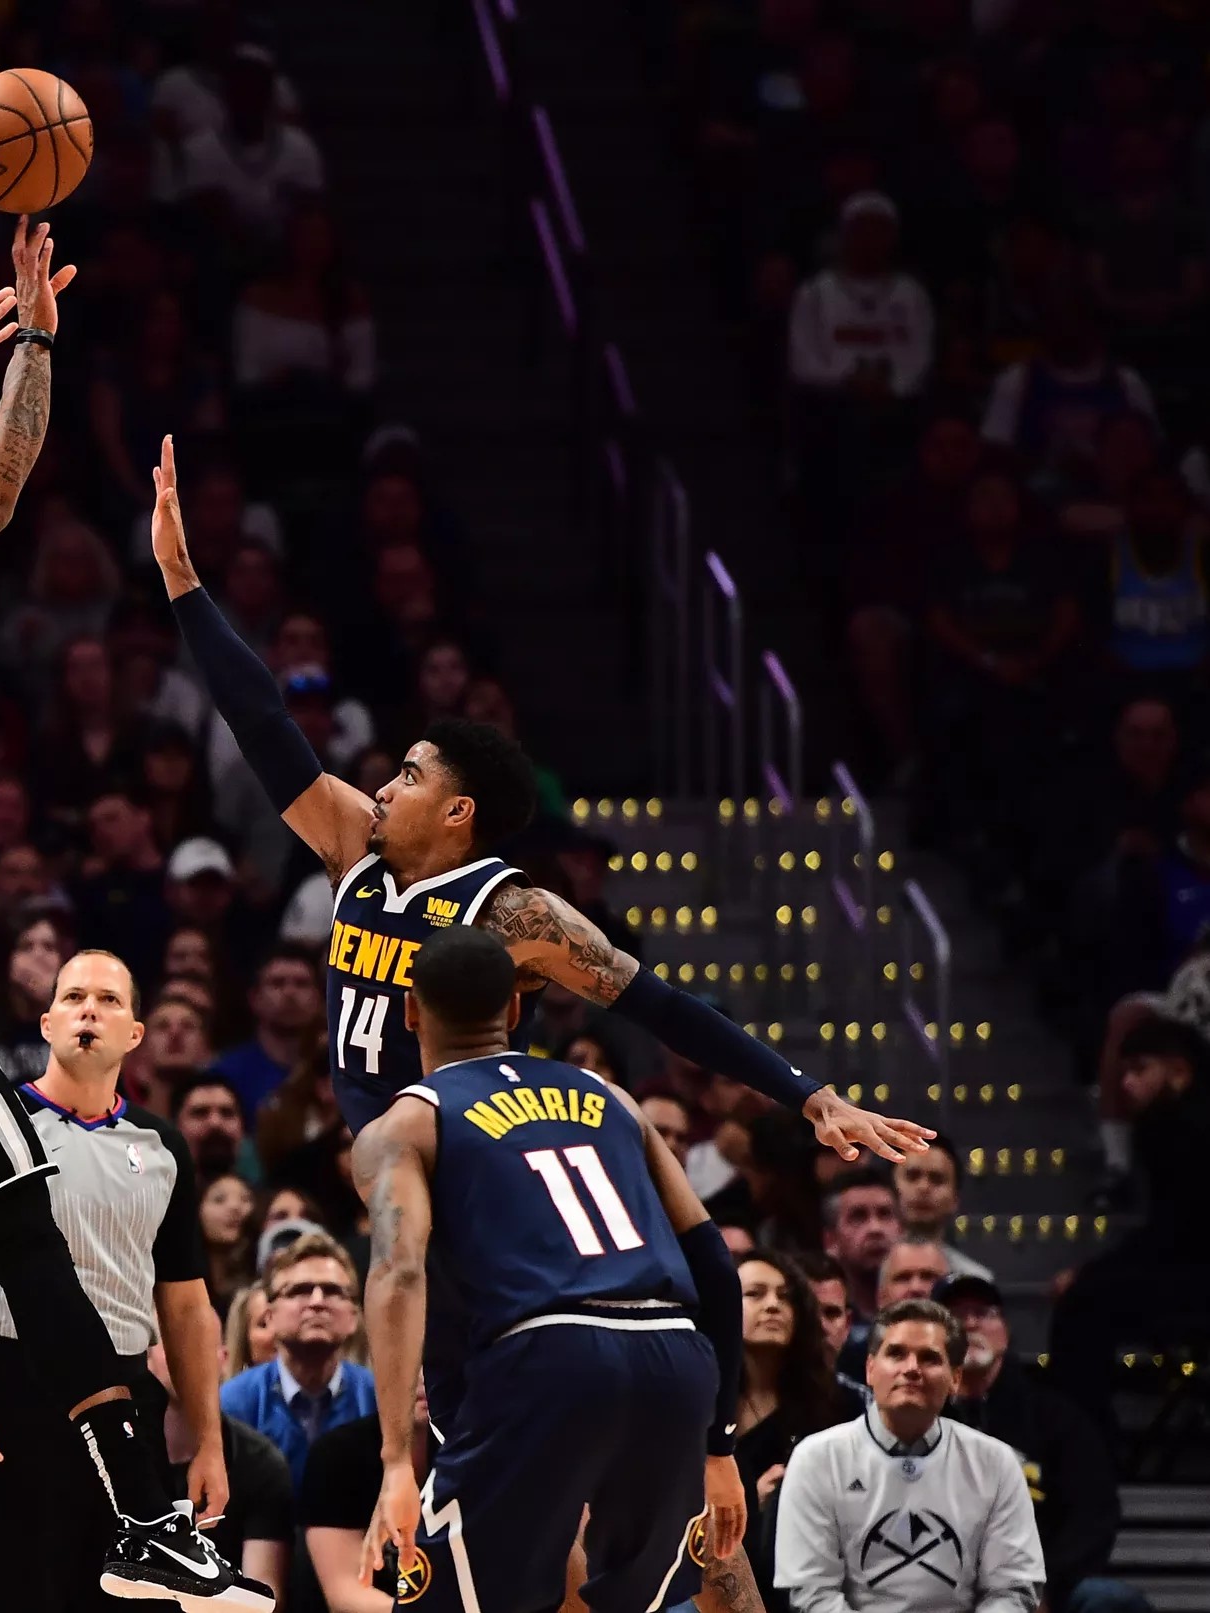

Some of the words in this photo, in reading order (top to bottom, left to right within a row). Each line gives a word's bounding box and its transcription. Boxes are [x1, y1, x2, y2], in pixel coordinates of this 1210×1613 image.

[422, 913, 454, 924] WESTERN
[427, 896, 460, 918] WU
[328, 919, 422, 988] DENVE
[337, 986, 390, 1075] 14
[463, 1087, 606, 1140] MORRIS
[522, 1145, 646, 1257] 11
